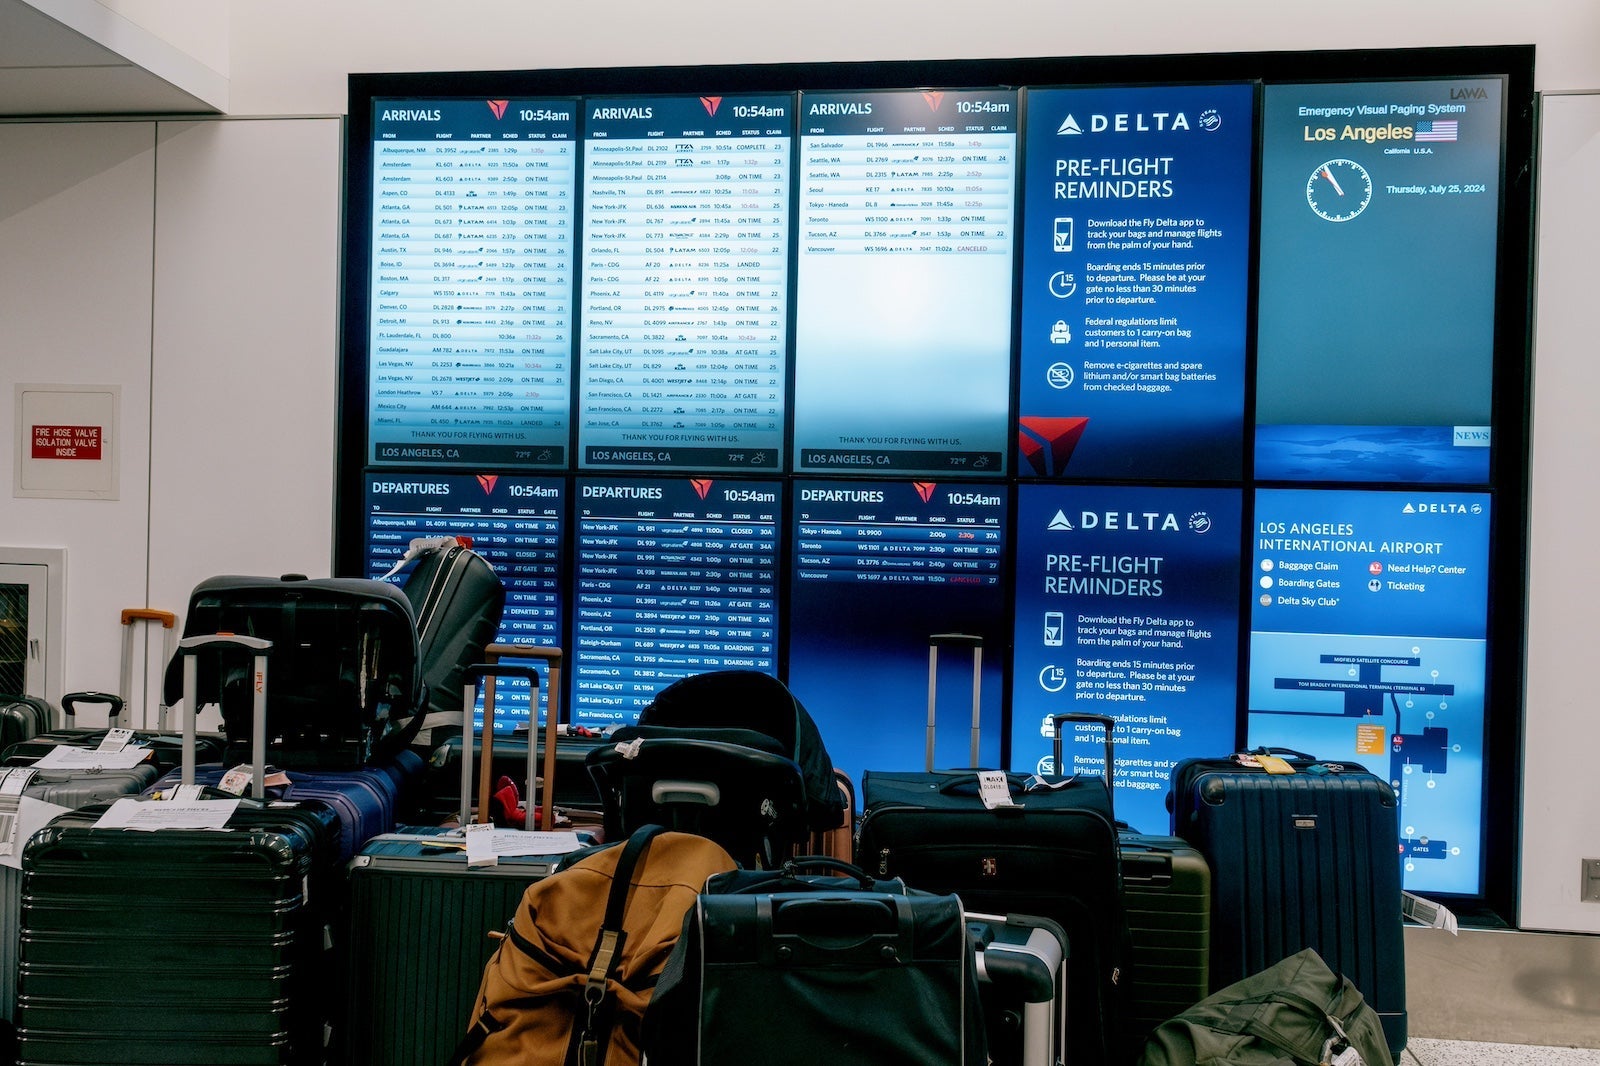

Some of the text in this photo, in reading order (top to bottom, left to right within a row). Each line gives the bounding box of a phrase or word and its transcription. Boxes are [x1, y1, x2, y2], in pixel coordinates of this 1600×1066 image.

[1449, 87, 1487, 100] LAWA
[592, 105, 784, 119] ARRIVALS 10:54am
[809, 101, 1009, 115] ARRIVALS 10:54am
[1298, 103, 1465, 117] Emergency Visual Paging System
[381, 109, 569, 120] ARRIVALS 10:54am
[1091, 112, 1189, 132] DELTA
[1304, 123, 1413, 143] Los Angeles
[1056, 157, 1173, 176] PRE-FLIGHT
[1054, 179, 1172, 198] REMINDERS
[1385, 184, 1485, 195] Thursday, July 25, 2024
[1087, 218, 1127, 227] Download
[1128, 218, 1141, 227] the
[1143, 218, 1154, 228] Fly
[1156, 218, 1177, 226] Delta
[1087, 230, 1107, 238] track
[1127, 229, 1146, 239] bags
[1147, 229, 1163, 237] and
[1164, 230, 1195, 238] manage
[1197, 228, 1222, 238] flights
[1086, 240, 1105, 249] from
[1107, 240, 1120, 249] the
[1121, 240, 1141, 250] palm
[1142, 240, 1151, 248] of
[1171, 240, 1193, 248] hand.
[1086, 262, 1205, 272] Boarding ends 15 minutes prior
[1065, 274, 1074, 282] 15
[1095, 273, 1136, 283] departure.
[1139, 273, 1165, 281] Please
[1166, 273, 1176, 281] be
[1187, 274, 1206, 282] your
[1085, 285, 1103, 294] gate
[1115, 284, 1131, 292] less
[1132, 284, 1150, 292] than
[1151, 284, 1163, 292] 30
[1164, 284, 1196, 292] minutes
[1085, 295, 1104, 304] prior
[1115, 295, 1156, 304] departure.
[1085, 317, 1177, 327] Federal regulations limit
[1176, 328, 1191, 338] bag
[1084, 339, 1099, 347] and
[1105, 339, 1139, 348] personal
[1140, 339, 1160, 347] item.
[1084, 360, 1114, 369] Remove
[1116, 361, 1162, 370] e-cigarettes
[1163, 361, 1178, 369] and
[1083, 371, 1110, 380] lithium
[1112, 372, 1138, 380] and/or
[1164, 372, 1180, 382] bag
[1180, 372, 1216, 380] batteries
[1103, 382, 1135, 391] checked
[1136, 383, 1172, 392] baggage.
[35, 427, 97, 437] FIRE HOSE VALVE
[1455, 432, 1489, 440] NEWS
[35, 437, 96, 447] ISOLATION VALVE
[55, 447, 76, 456] INSIDE
[592, 451, 671, 461] LOS ANGELES, CA
[808, 454, 890, 465] LOS ANGELES, CA
[372, 482, 558, 497] DEPARTURES 10:54am
[582, 486, 774, 501] DEPARTURES 10:54am
[801, 489, 1000, 505] DEPARTURES 10:54am
[1418, 503, 1466, 513] DELTA
[1081, 511, 1179, 530] DELTA
[1260, 522, 1353, 535] LOS ANGELES
[1259, 538, 1442, 554] INTERNATIONAL AIRPORT
[1046, 554, 1163, 574] PRE-FLIGHT
[1278, 560, 1338, 571] Baggage Claim
[1387, 564, 1466, 574] Need Help? Center
[1045, 576, 1162, 596] REMINDERS
[1278, 578, 1340, 589] Boarding Gates
[1386, 581, 1424, 592] Ticketing
[1277, 596, 1300, 605] Delta
[1301, 596, 1316, 606] Sky
